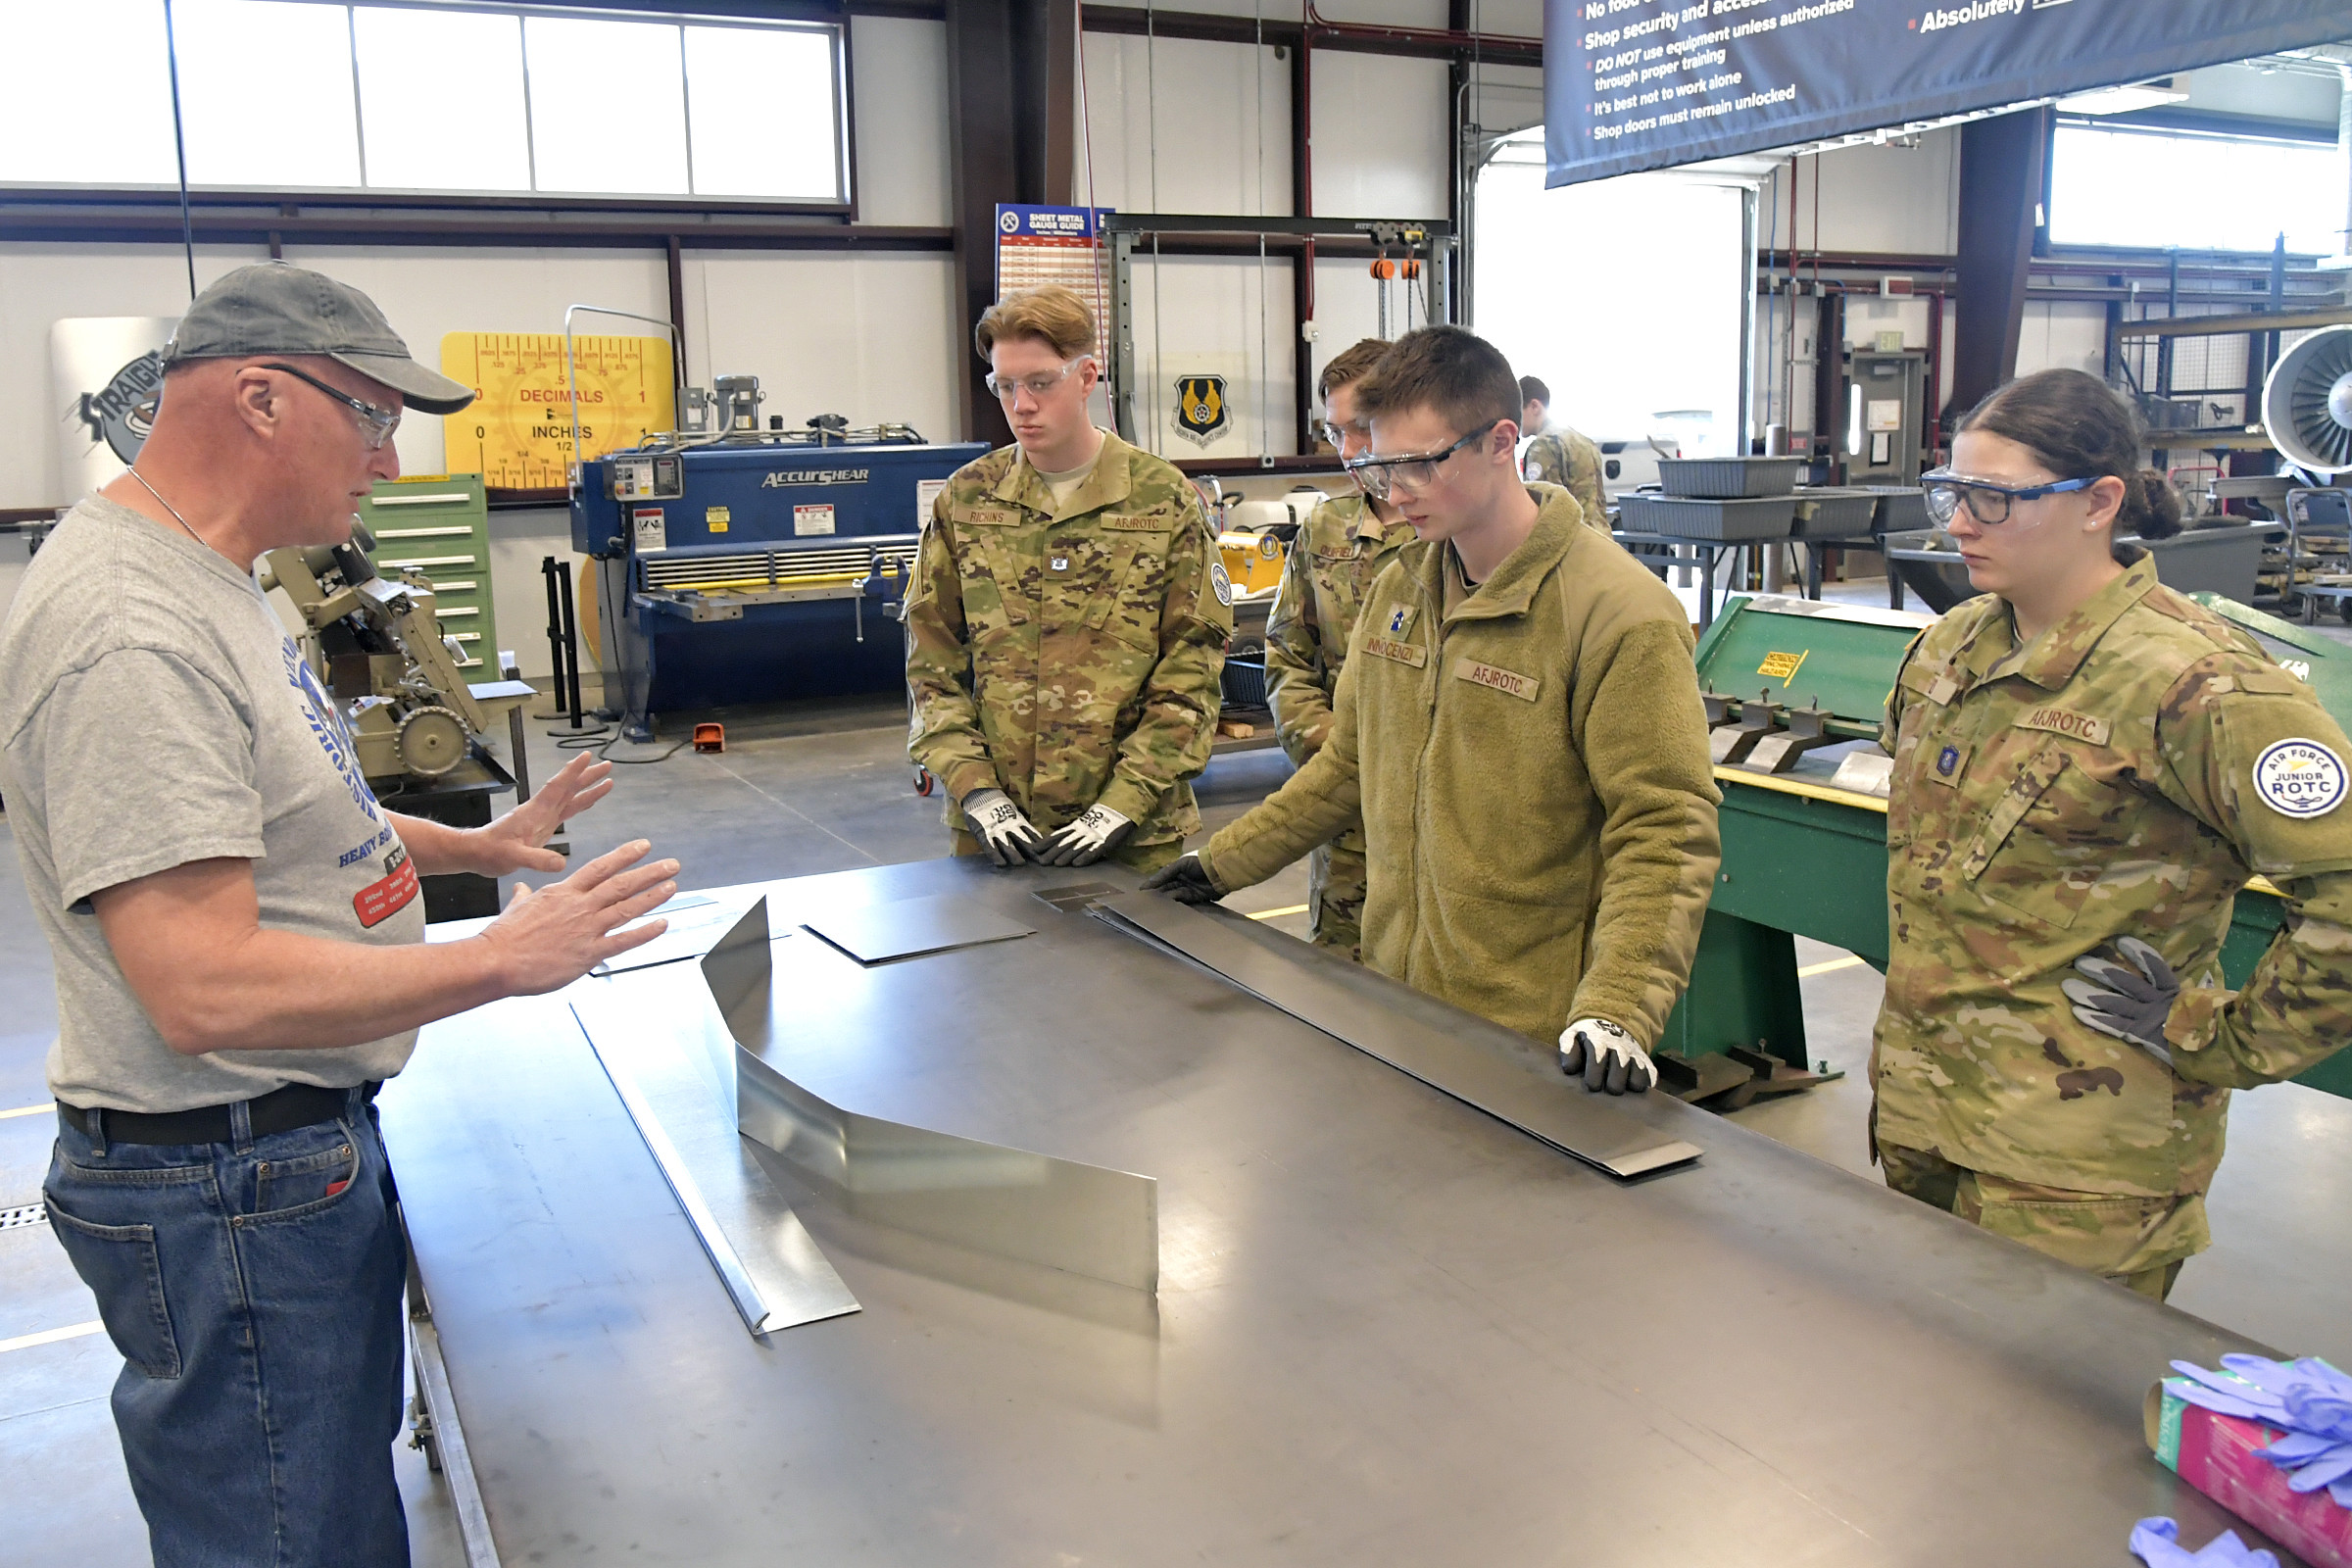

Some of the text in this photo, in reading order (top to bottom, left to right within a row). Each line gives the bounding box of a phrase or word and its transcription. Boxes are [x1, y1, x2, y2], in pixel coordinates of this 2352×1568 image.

[1586, 2, 1605, 20] No
[1920, 0, 2025, 33] Absolutely
[1585, 29, 1620, 50] Shop
[1623, 12, 1679, 39] security
[1682, 0, 1708, 24] and
[1594, 0, 1854, 74] DO NOT use equipment unless authorized
[1594, 49, 1726, 91] through proper training
[1594, 72, 1741, 116] It's best not to work alone
[1593, 83, 1795, 140] Shop doors must remain unlocked
[81, 350, 161, 442] STRAIGH
[520, 389, 604, 403] DECIMALS
[475, 425, 485, 439] 0
[532, 425, 592, 439] INCHES
[556, 442, 572, 451] 1/2
[969, 511, 1004, 523] RICHINS
[1114, 515, 1159, 530] AFJROTC
[1367, 638, 1414, 662] INNOCENZI
[1472, 666, 1523, 693] AFJROTC
[2028, 710, 2096, 738] AFJROTC
[2269, 750, 2330, 770] AIR FORCE
[2272, 781, 2331, 795] ROTC
[2275, 772, 2324, 782] JUNIOR
[339, 836, 376, 867] HEAVY
